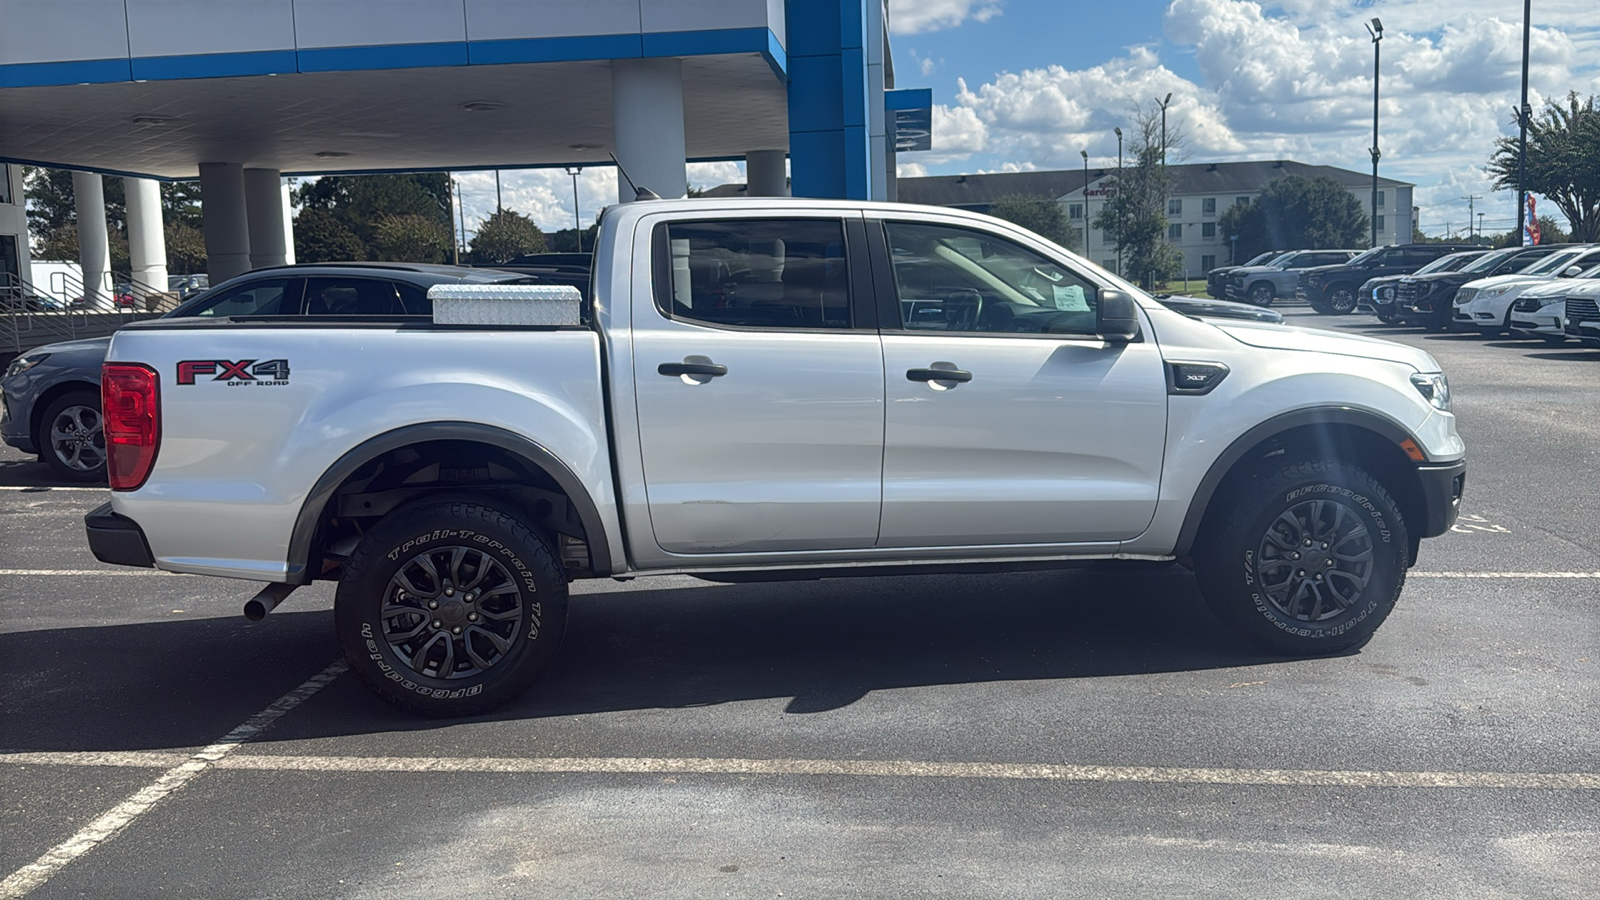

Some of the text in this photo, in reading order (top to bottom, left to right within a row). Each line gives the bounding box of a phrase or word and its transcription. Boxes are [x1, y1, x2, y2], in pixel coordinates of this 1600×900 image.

[1083, 187, 1117, 196] Garden
[176, 359, 290, 385] FX4
[1286, 484, 1391, 543] BFGoodrich
[387, 529, 541, 640] Trail-Terrain T/A
[1244, 550, 1377, 638] Trail-Terrain T/A
[361, 623, 483, 699] BFGoodrich
